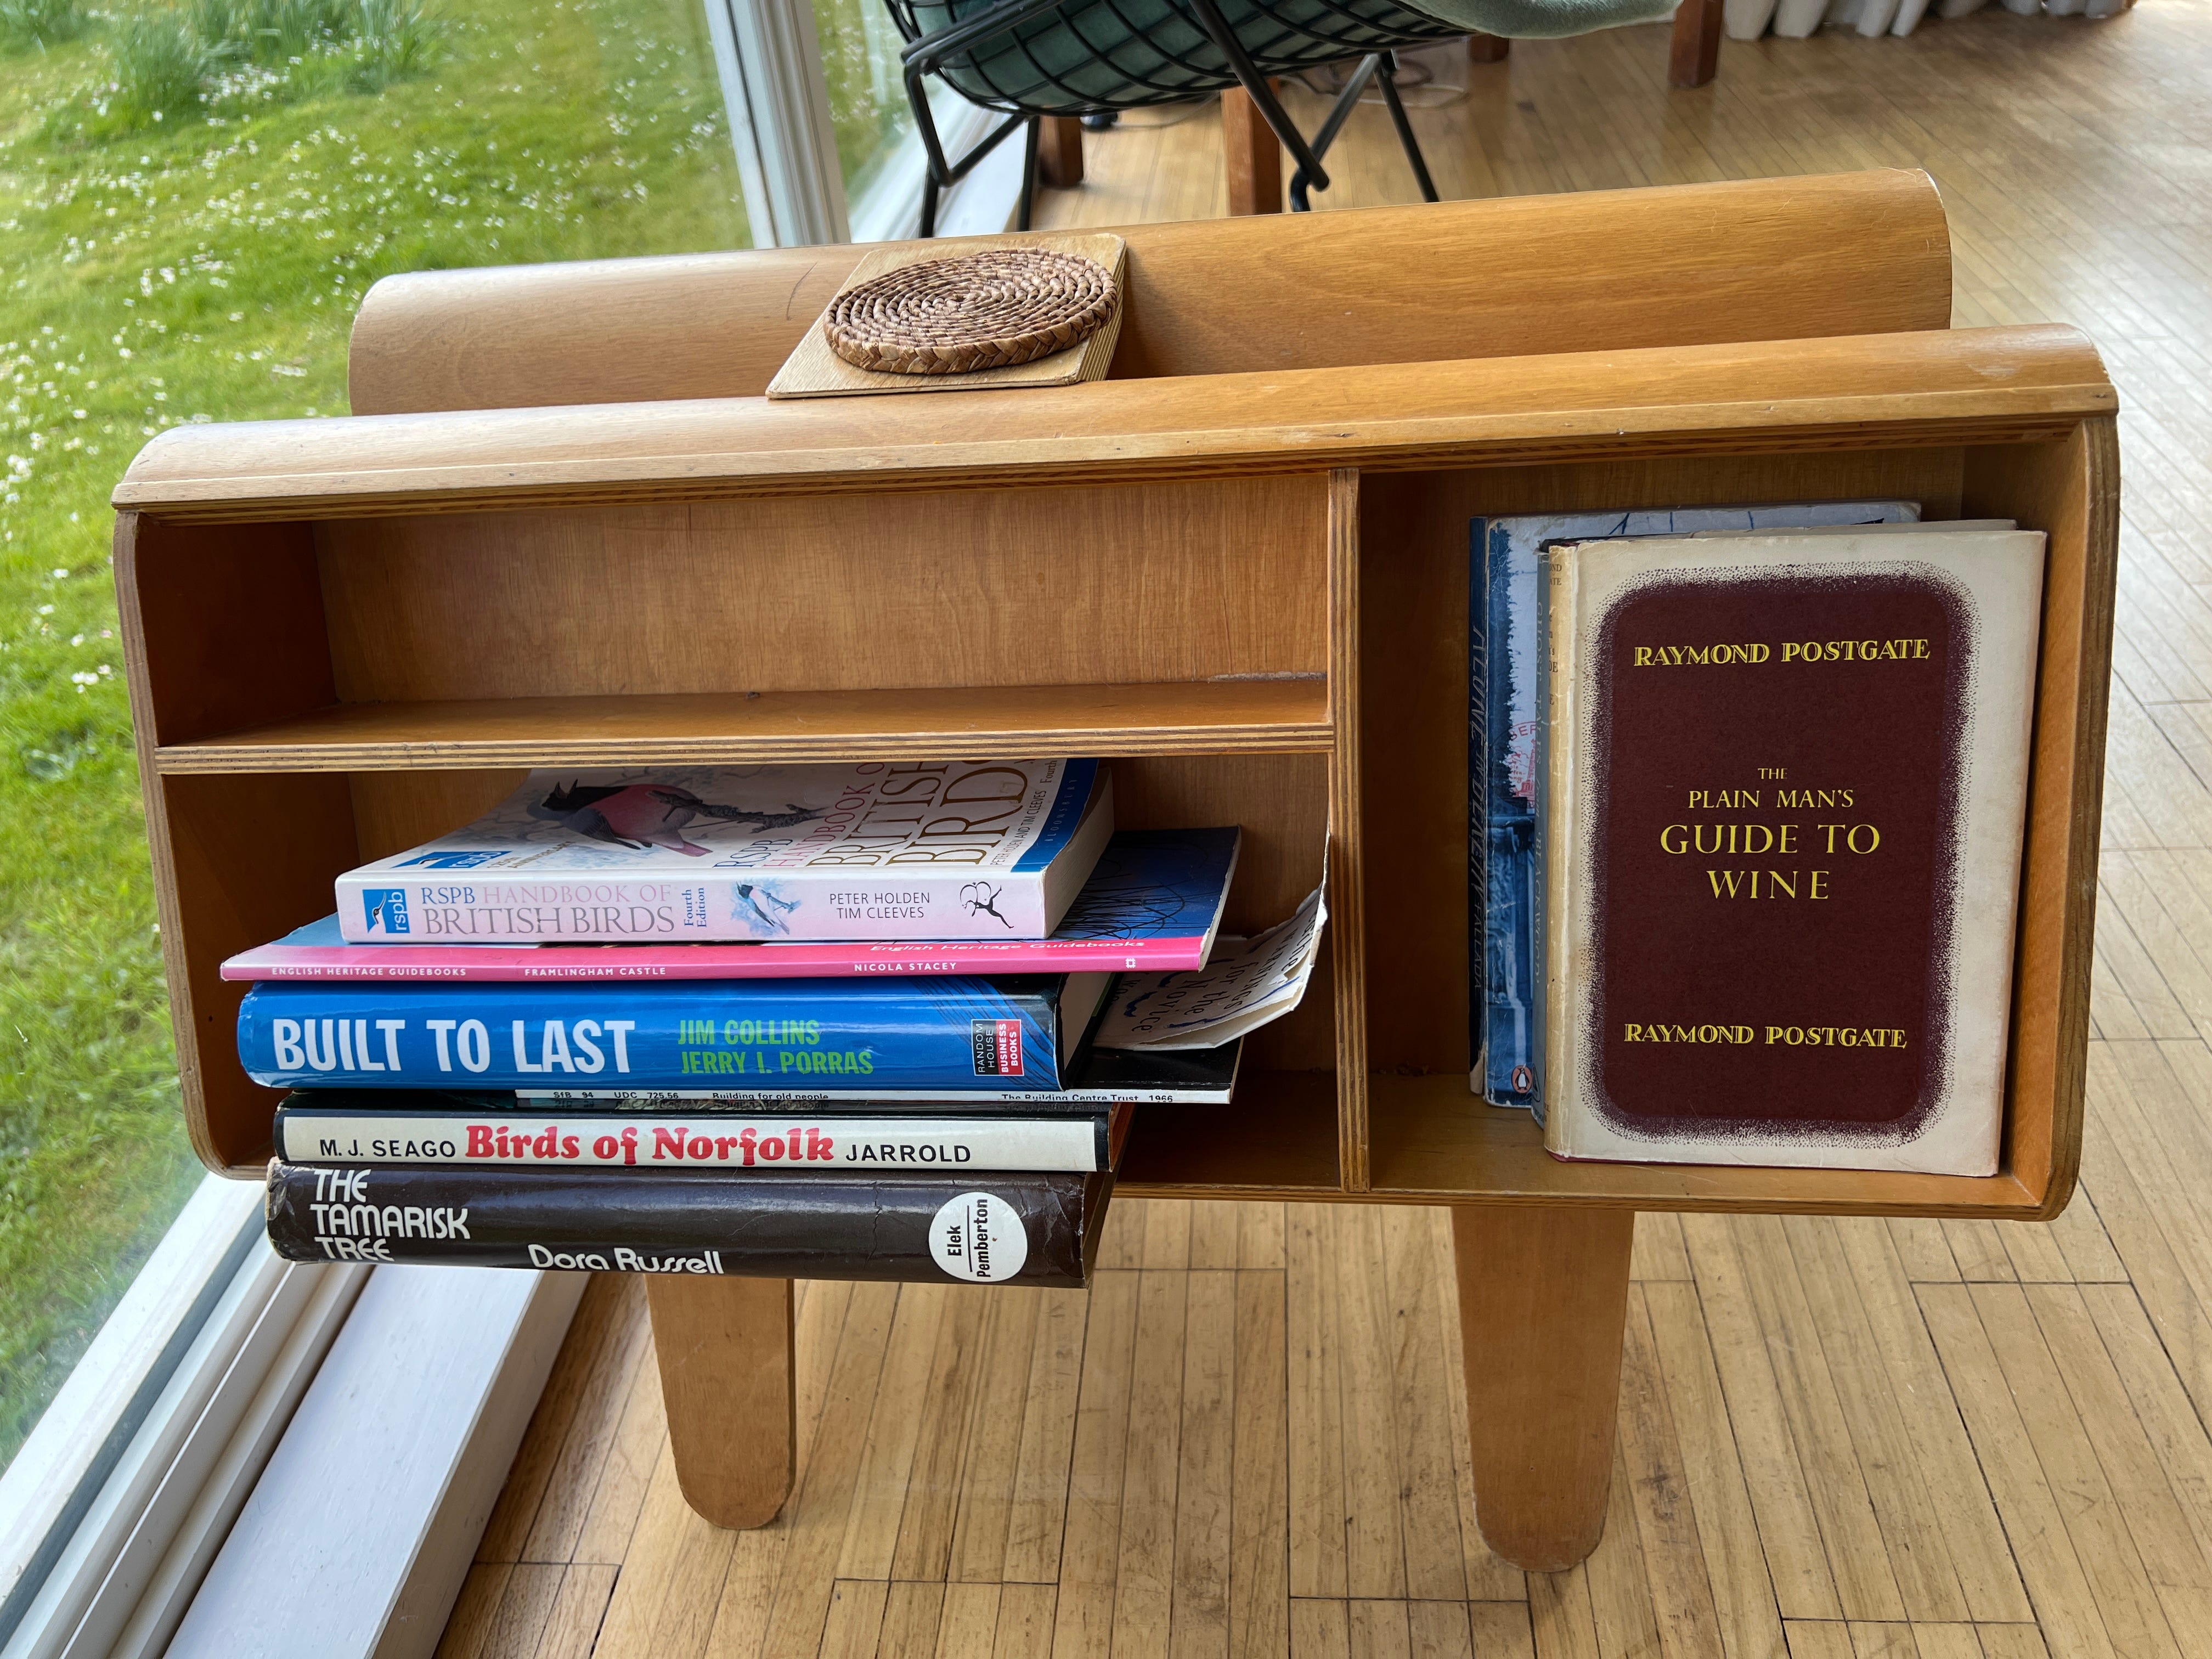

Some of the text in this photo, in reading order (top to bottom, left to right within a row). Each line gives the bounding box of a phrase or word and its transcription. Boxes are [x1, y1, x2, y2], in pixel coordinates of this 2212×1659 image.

[1634, 639, 1930, 666] RAYMOND POSTGATE
[1040, 760, 1058, 783] Fourth
[1758, 768, 1788, 780] THE
[884, 760, 1028, 866] BIRD
[1027, 790, 1047, 815] CLEEVES
[1689, 788, 1854, 809] PLAIN MAN'S
[763, 761, 885, 867] HANDBOOK O
[1021, 816, 1036, 826] TIM
[1015, 827, 1030, 839] AND
[1660, 824, 1881, 855] GUIDE TO
[448, 851, 502, 867] rspb
[712, 838, 793, 868] RSPB
[990, 853, 1008, 865] PETER
[421, 884, 672, 904] RSPB HANDBOOK OF
[830, 891, 930, 905] PETER HOLDEN
[1706, 870, 1830, 900] WINE
[395, 891, 408, 930] rspb
[424, 906, 675, 935] BRITISH BIRDS
[683, 889, 694, 927] Fourth
[697, 887, 707, 928] Edition
[837, 906, 925, 919] TIM CLEEVES
[940, 943, 1021, 951] Heritage
[1474, 903, 1482, 989] FALLADA
[272, 962, 957, 977] ENGLISH HERITAGE GUIDEBOOKS FRAMLINGHAM CASTLE NICOLA STACEY
[1183, 961, 1261, 1015] for the
[1131, 978, 1210, 1032] Novice
[273, 1018, 635, 1074] BUILT TO LAST
[678, 1019, 820, 1045] JIM COLLINS
[1624, 1024, 1908, 1049] RAYMOND POSTGATE
[681, 1051, 746, 1074] JERRY
[780, 1051, 874, 1074] PORRAS
[976, 1023, 986, 1073] RANDOM
[986, 1028, 995, 1068] HOUSE
[998, 1023, 1009, 1073] BUSINESS
[1009, 1031, 1019, 1067] BOOKS
[713, 1092, 755, 1100] Building
[320, 1126, 971, 1166] M. J. SEAGO Birds of Norfolk JARROLD
[314, 1168, 372, 1203] THE
[310, 1204, 471, 1240] TAMARISK
[314, 1237, 395, 1263] TREE
[947, 1224, 962, 1257] Elek
[977, 1198, 991, 1278] Pemberton
[528, 1243, 724, 1274] Dora Russell
